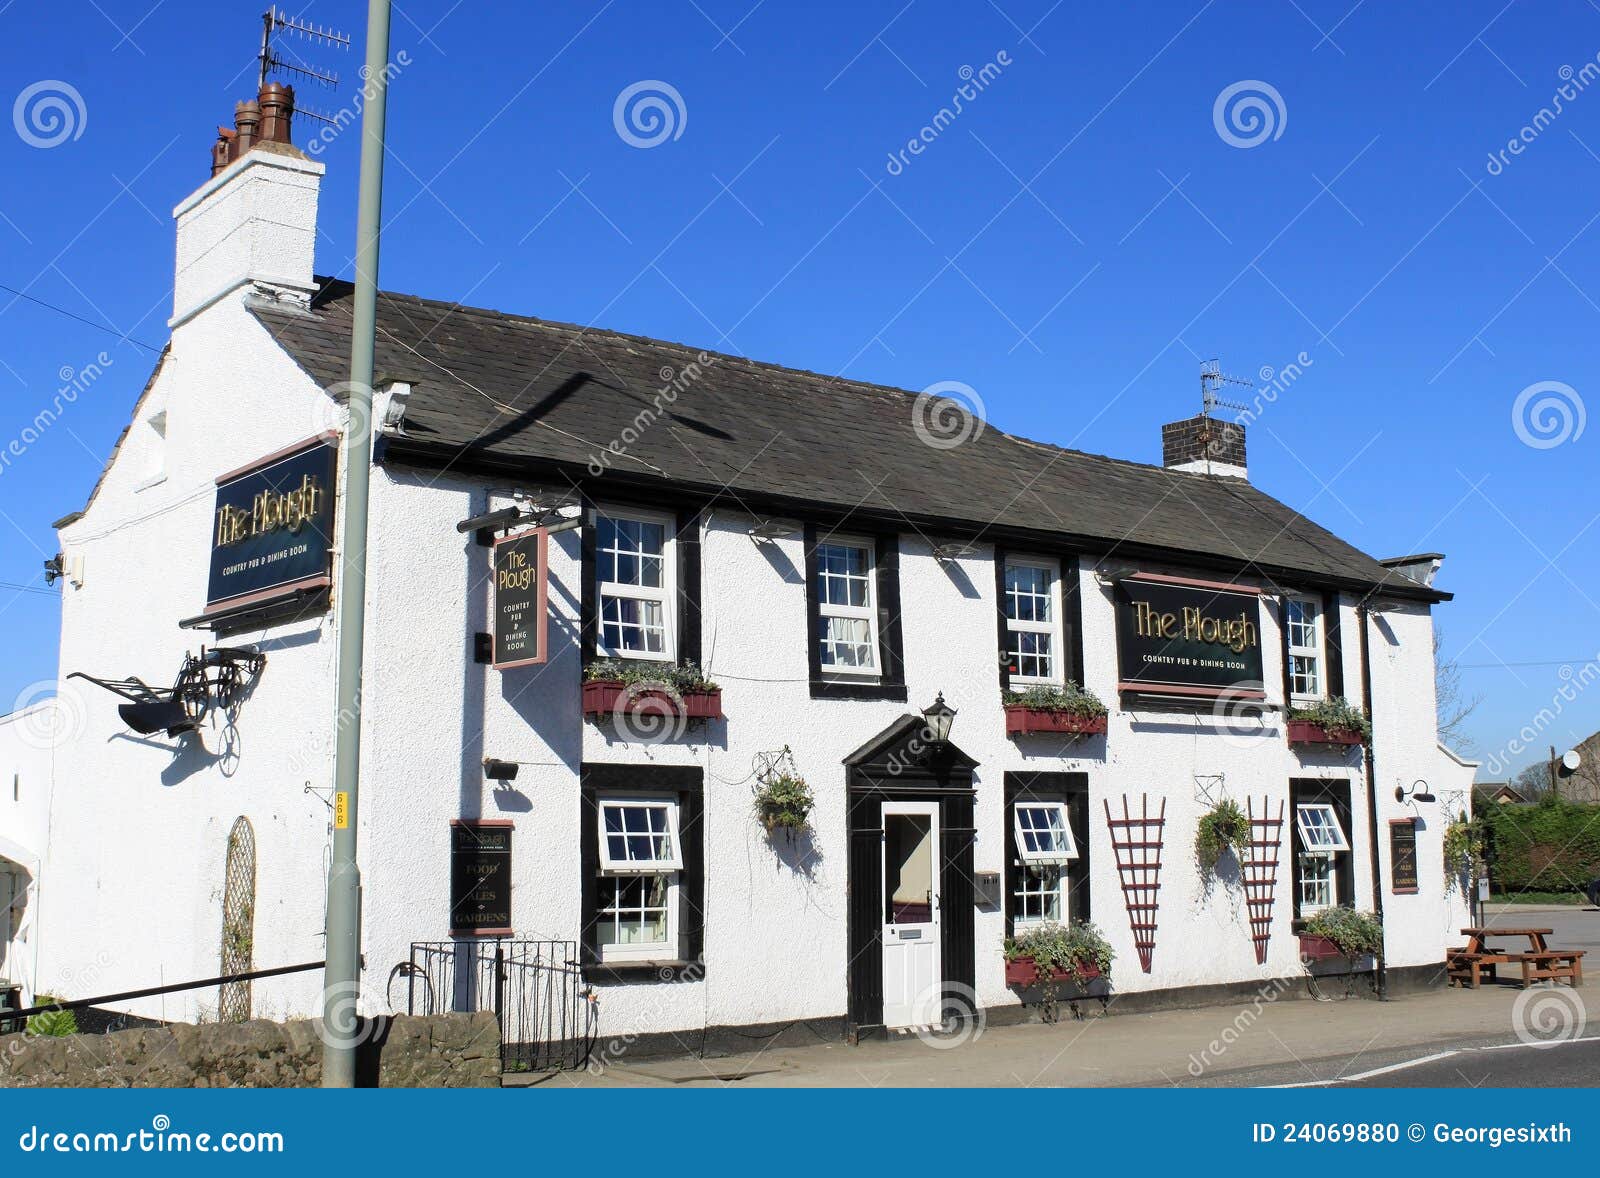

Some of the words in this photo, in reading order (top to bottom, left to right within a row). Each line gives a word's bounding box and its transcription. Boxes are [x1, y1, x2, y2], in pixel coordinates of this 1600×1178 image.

[217, 503, 248, 546] The
[251, 474, 318, 535] Plough
[222, 561, 247, 577] COUNTRY
[248, 558, 260, 569] PUB
[267, 549, 288, 565] DINING
[290, 543, 308, 556] ROOM
[507, 550, 526, 570] The
[500, 564, 536, 591] Plough
[503, 601, 530, 613] COUNTRY
[511, 613, 522, 621] PUB
[1131, 600, 1180, 640] The
[1182, 606, 1257, 653] Plough
[505, 631, 527, 642] DINING
[507, 642, 525, 651] ROOM
[1142, 654, 1175, 665] COUNTRY
[1177, 657, 1190, 666] PUB
[1200, 659, 1224, 668] DINING
[1226, 661, 1246, 670] ROOM
